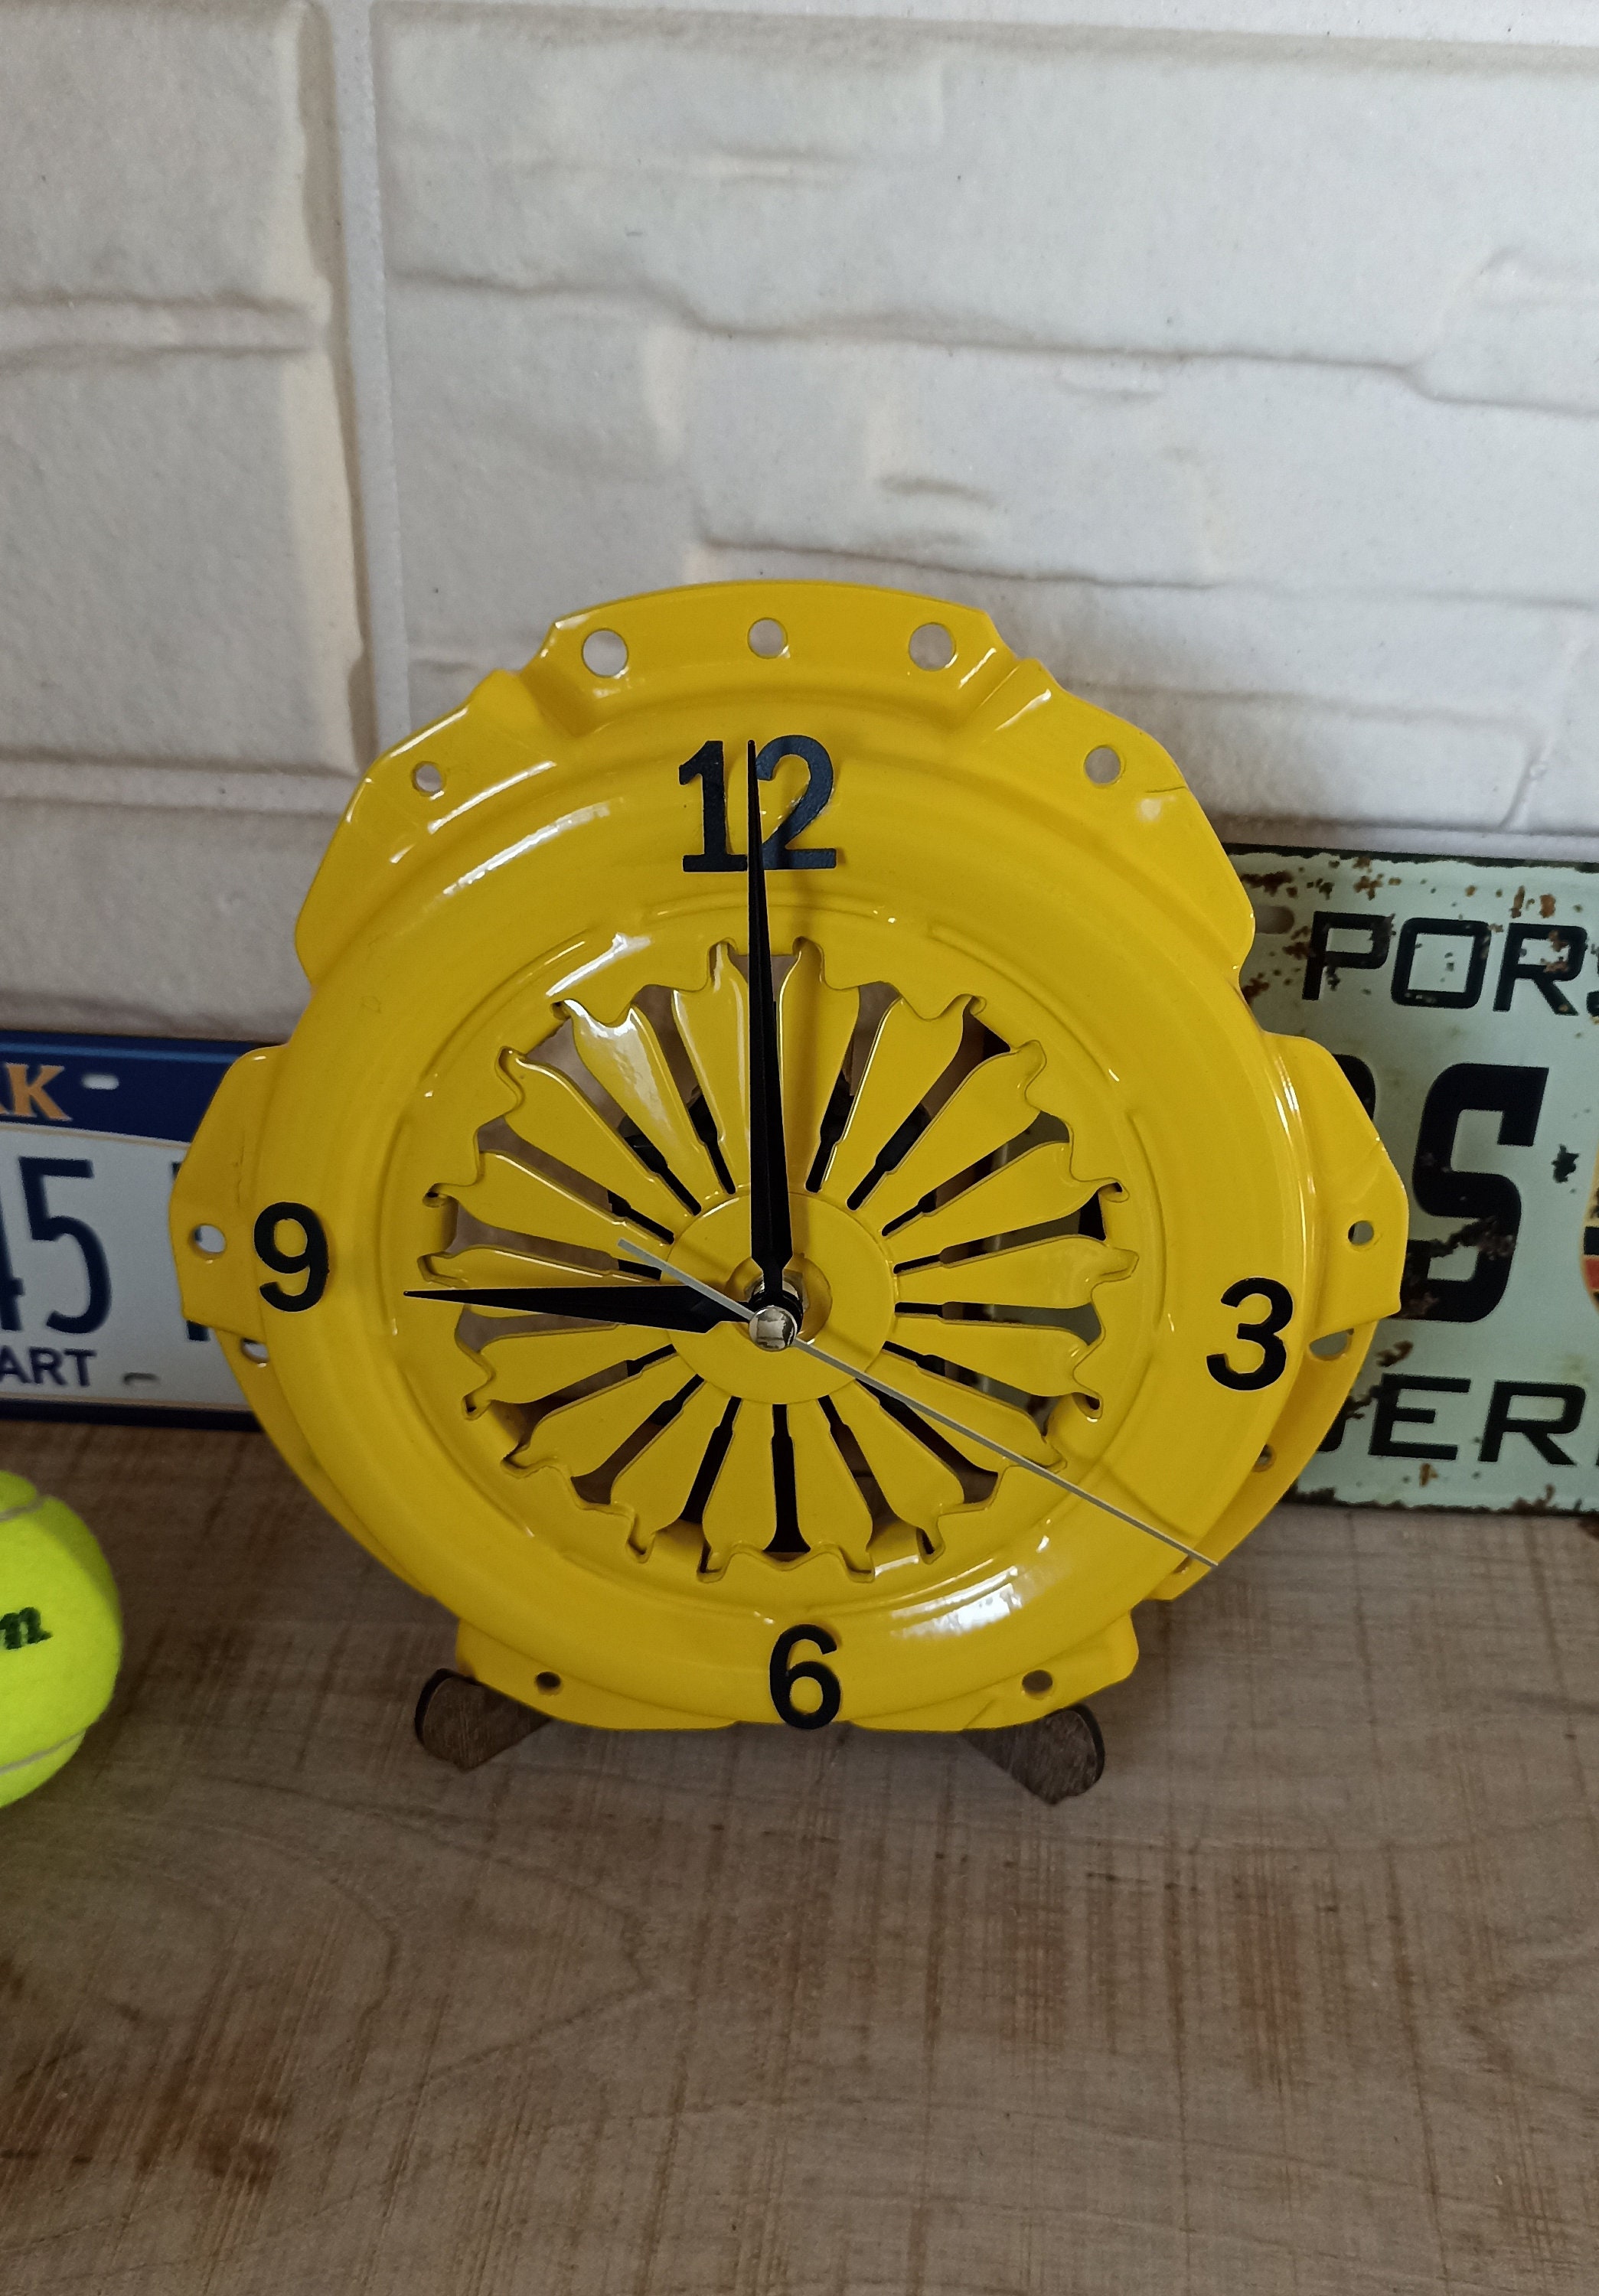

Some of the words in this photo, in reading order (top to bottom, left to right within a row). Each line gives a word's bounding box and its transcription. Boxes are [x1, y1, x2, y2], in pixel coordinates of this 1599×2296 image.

[678, 735, 837, 872] 12
[1302, 910, 1599, 1016] POR
[0, 1062, 73, 1121] K
[1333, 1054, 1549, 1323] S
[253, 1202, 329, 1312] 9
[1206, 1277, 1294, 1391] 3
[1317, 1373, 1599, 1466] ER
[769, 1623, 841, 1730] 6
